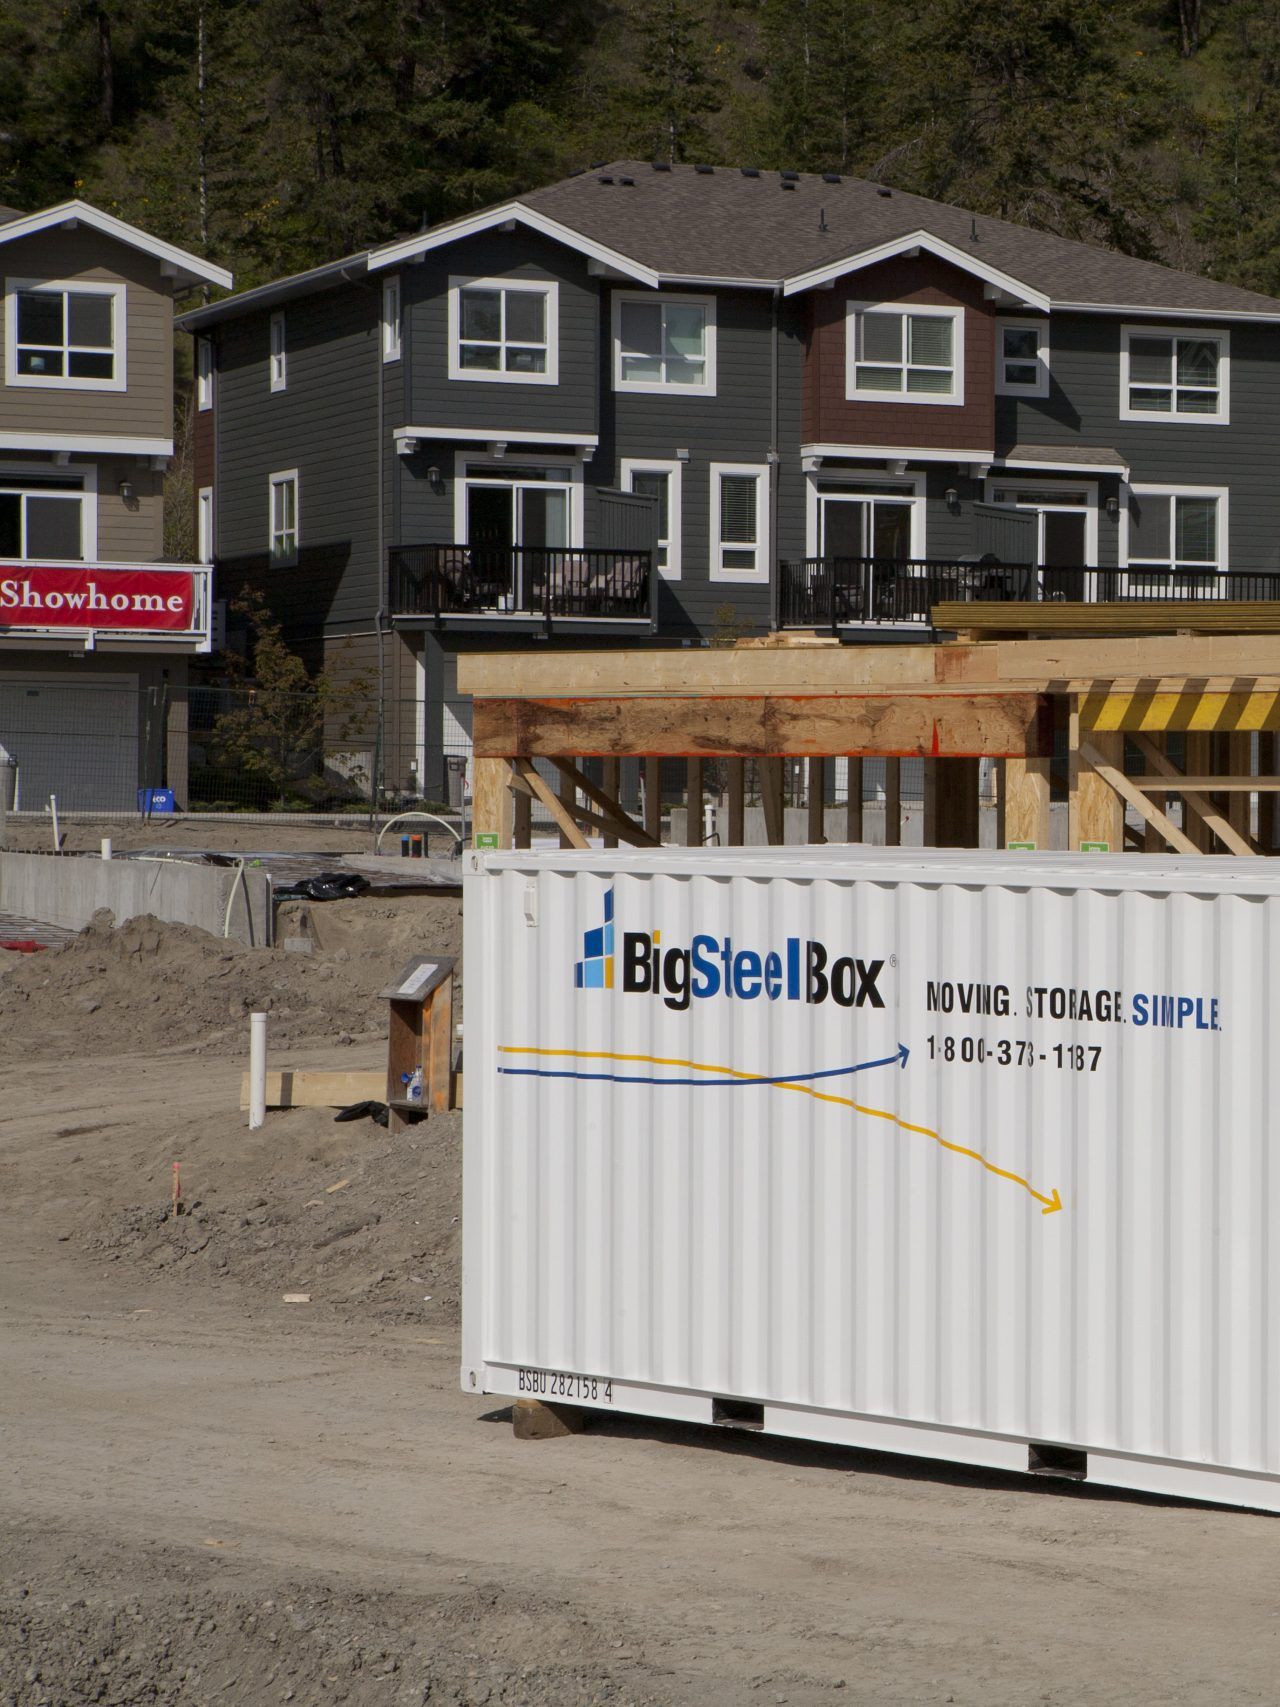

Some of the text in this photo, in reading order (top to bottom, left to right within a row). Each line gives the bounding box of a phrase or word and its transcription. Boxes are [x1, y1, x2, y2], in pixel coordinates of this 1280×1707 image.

[0, 580, 183, 612] Showhome
[623, 930, 886, 1011] BigSteelBox
[927, 981, 1222, 1031] MOVING. STORAGE. SIMPLE.
[519, 1368, 613, 1403] BSBU 282158 4
